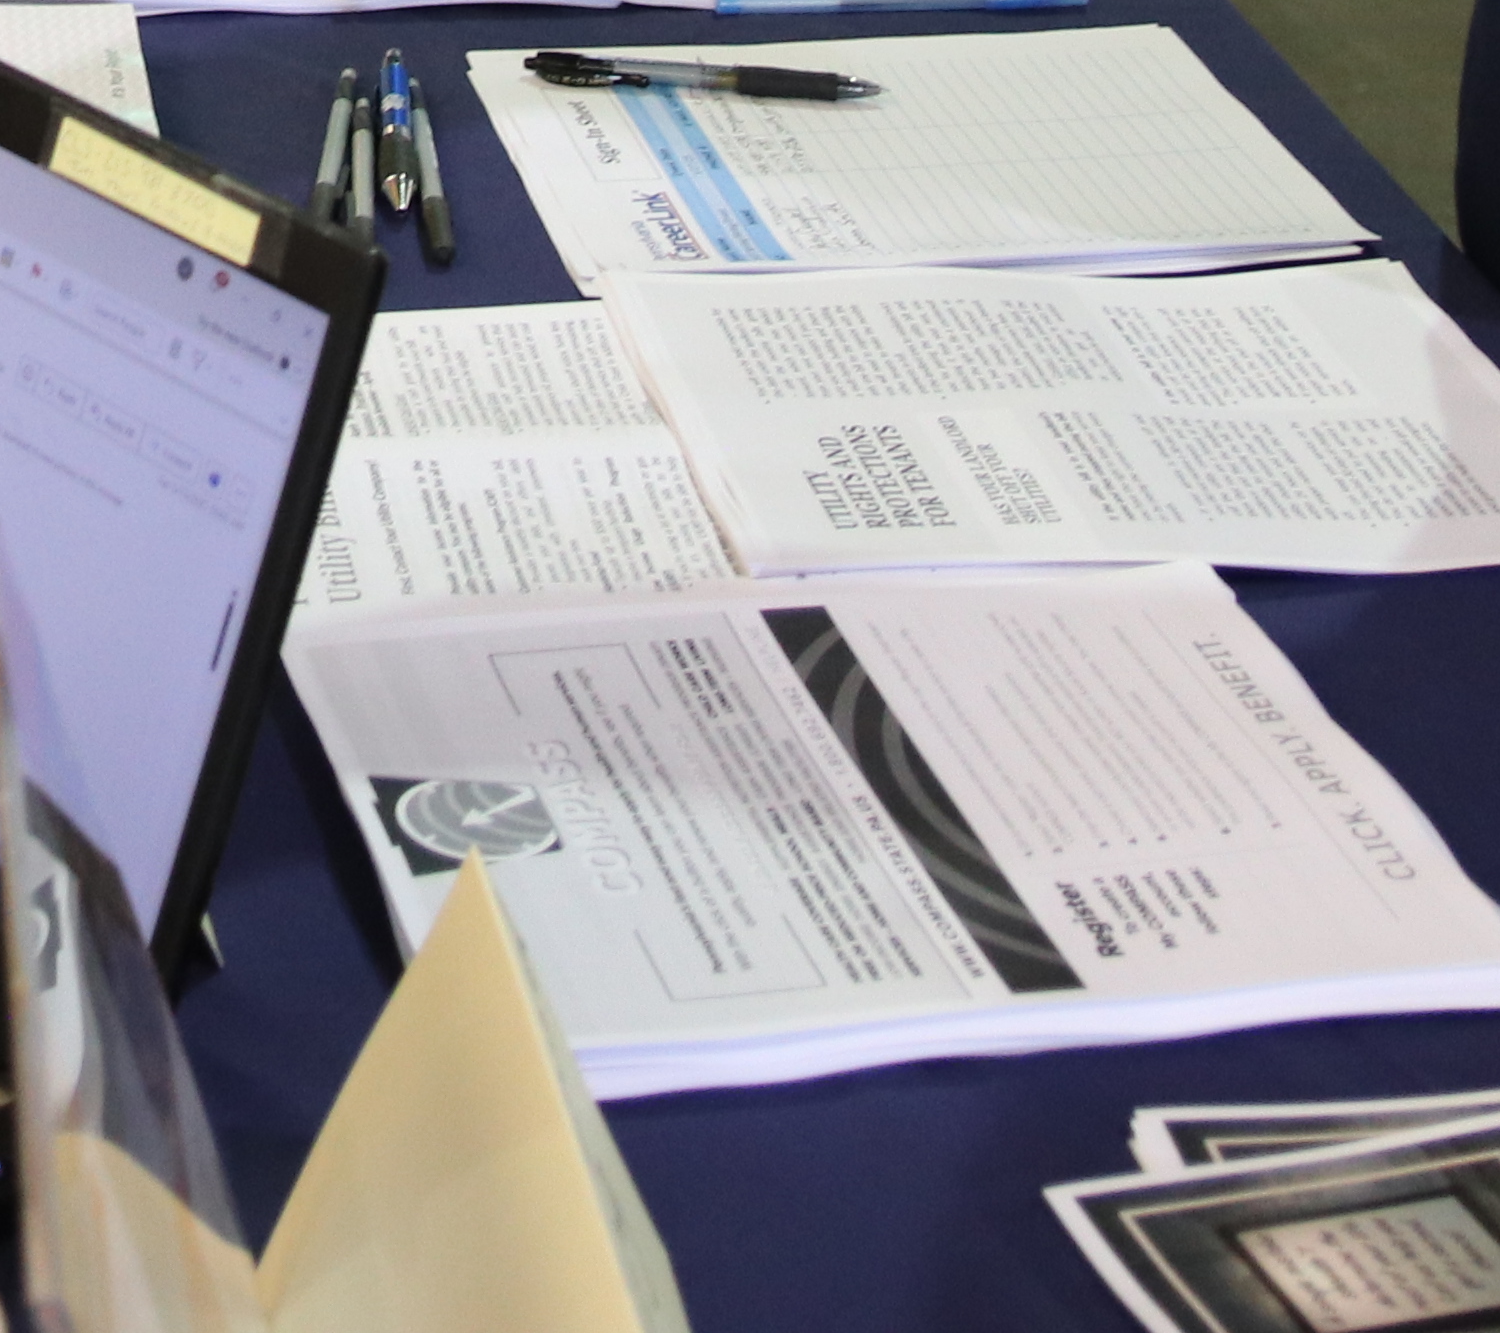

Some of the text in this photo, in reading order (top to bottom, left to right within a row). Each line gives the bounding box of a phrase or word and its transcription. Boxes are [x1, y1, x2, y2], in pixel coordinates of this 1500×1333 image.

[565, 101, 623, 164] Sign-In Sheet
[629, 192, 707, 260] CareerLink
[801, 470, 860, 529] UTILITY
[813, 435, 894, 528] RIGHTS AND
[837, 424, 925, 527] PROTECTIONS
[870, 424, 958, 526] FOR TENANTS
[934, 415, 1023, 524] HAS YOUR LANDLORD
[317, 533, 360, 603] Utility
[1185, 632, 1422, 881] CLICK. APPLY. BENEFIT.
[1046, 880, 1131, 958] Register
